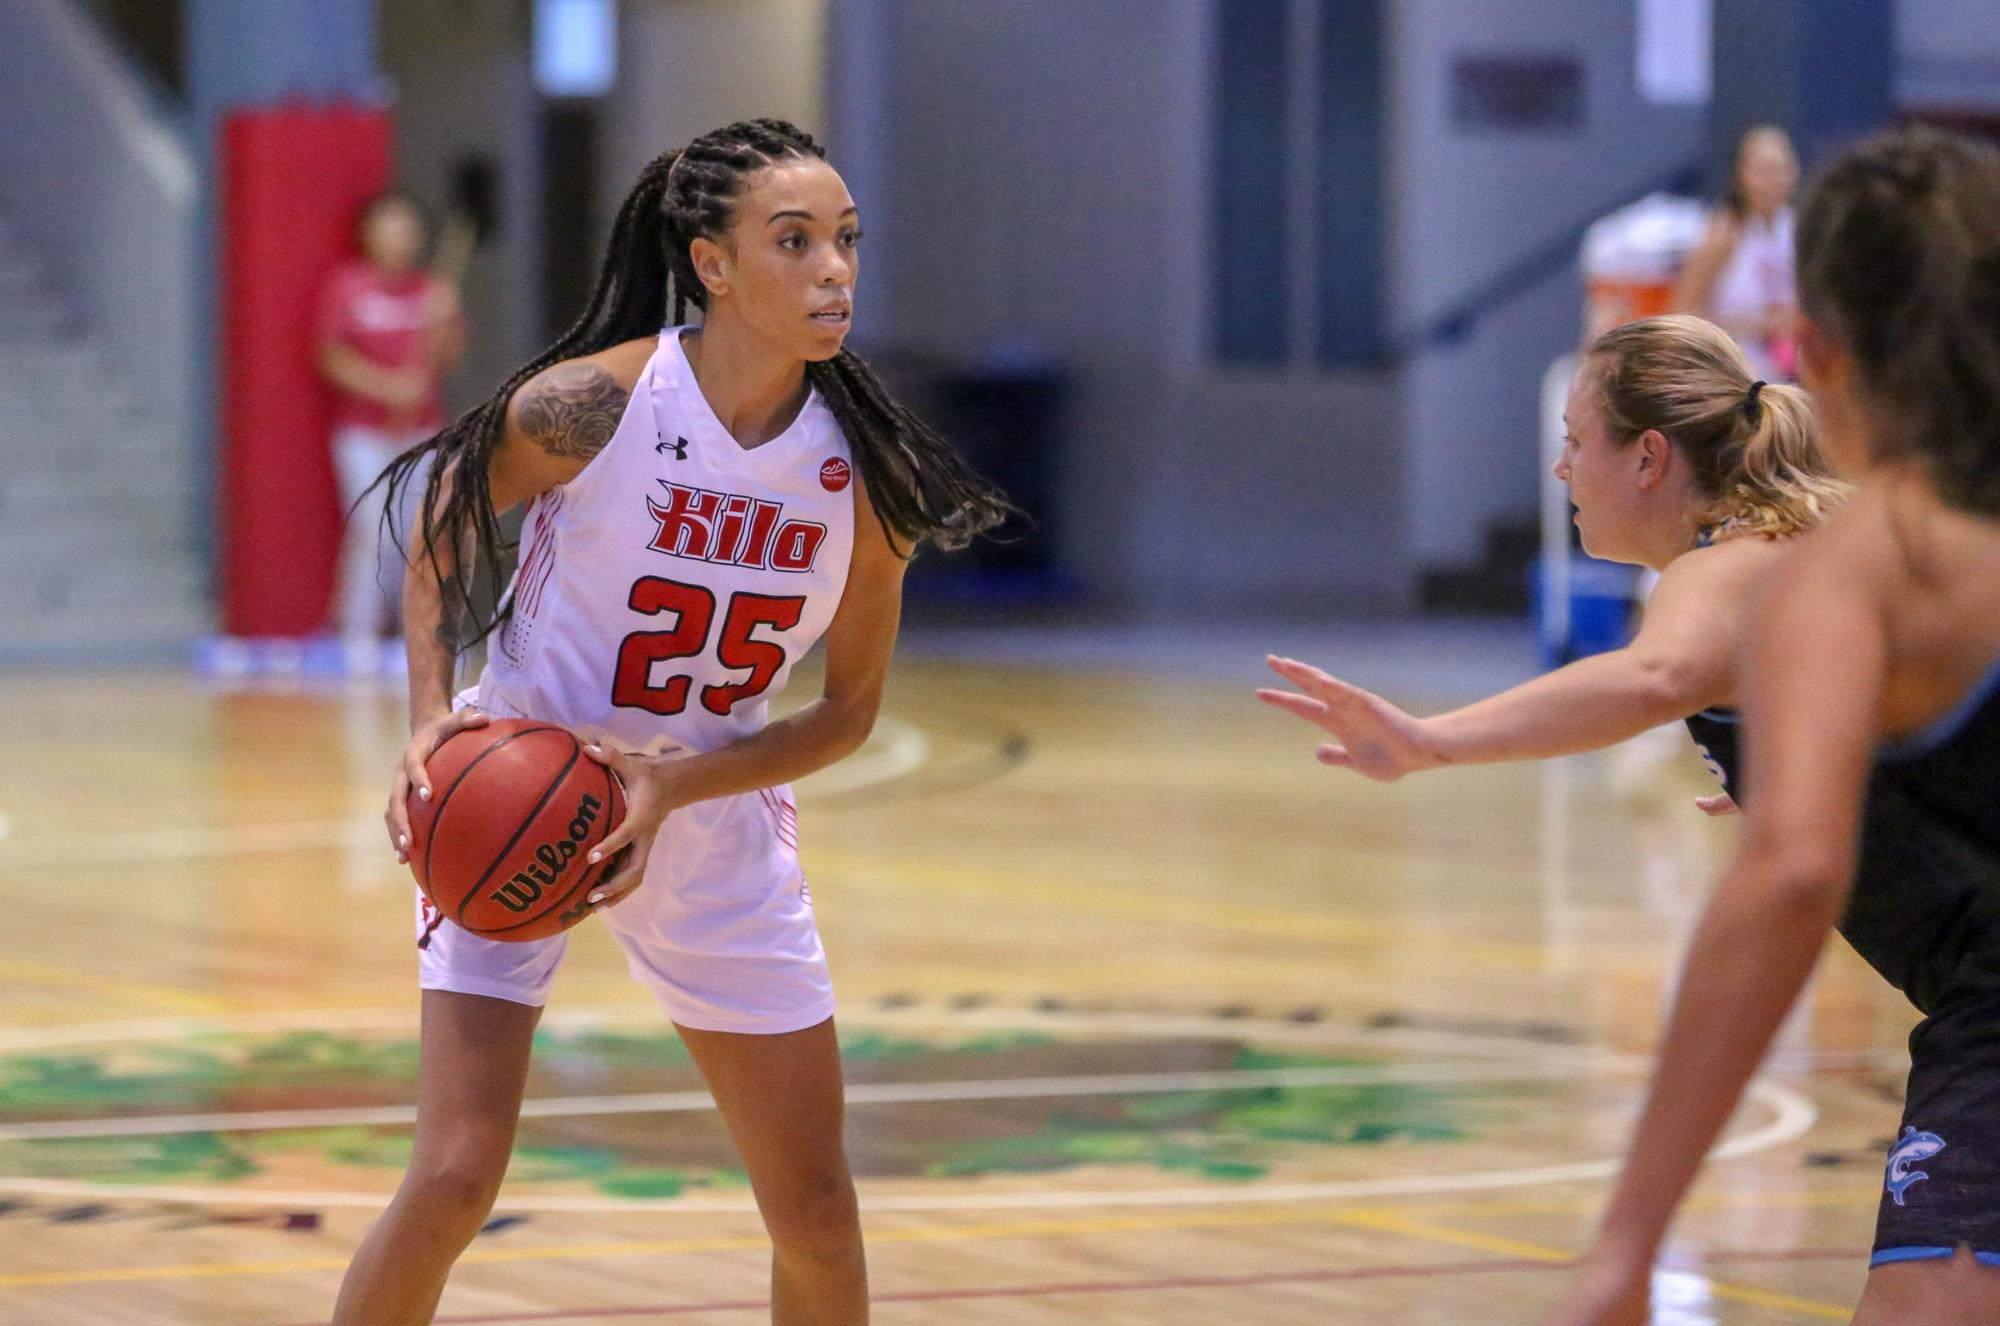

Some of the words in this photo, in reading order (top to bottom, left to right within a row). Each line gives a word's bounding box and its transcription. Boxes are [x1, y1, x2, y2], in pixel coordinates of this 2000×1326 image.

[646, 479, 828, 573] Hilo
[611, 575, 807, 716] 25
[489, 793, 602, 913] Wilson
